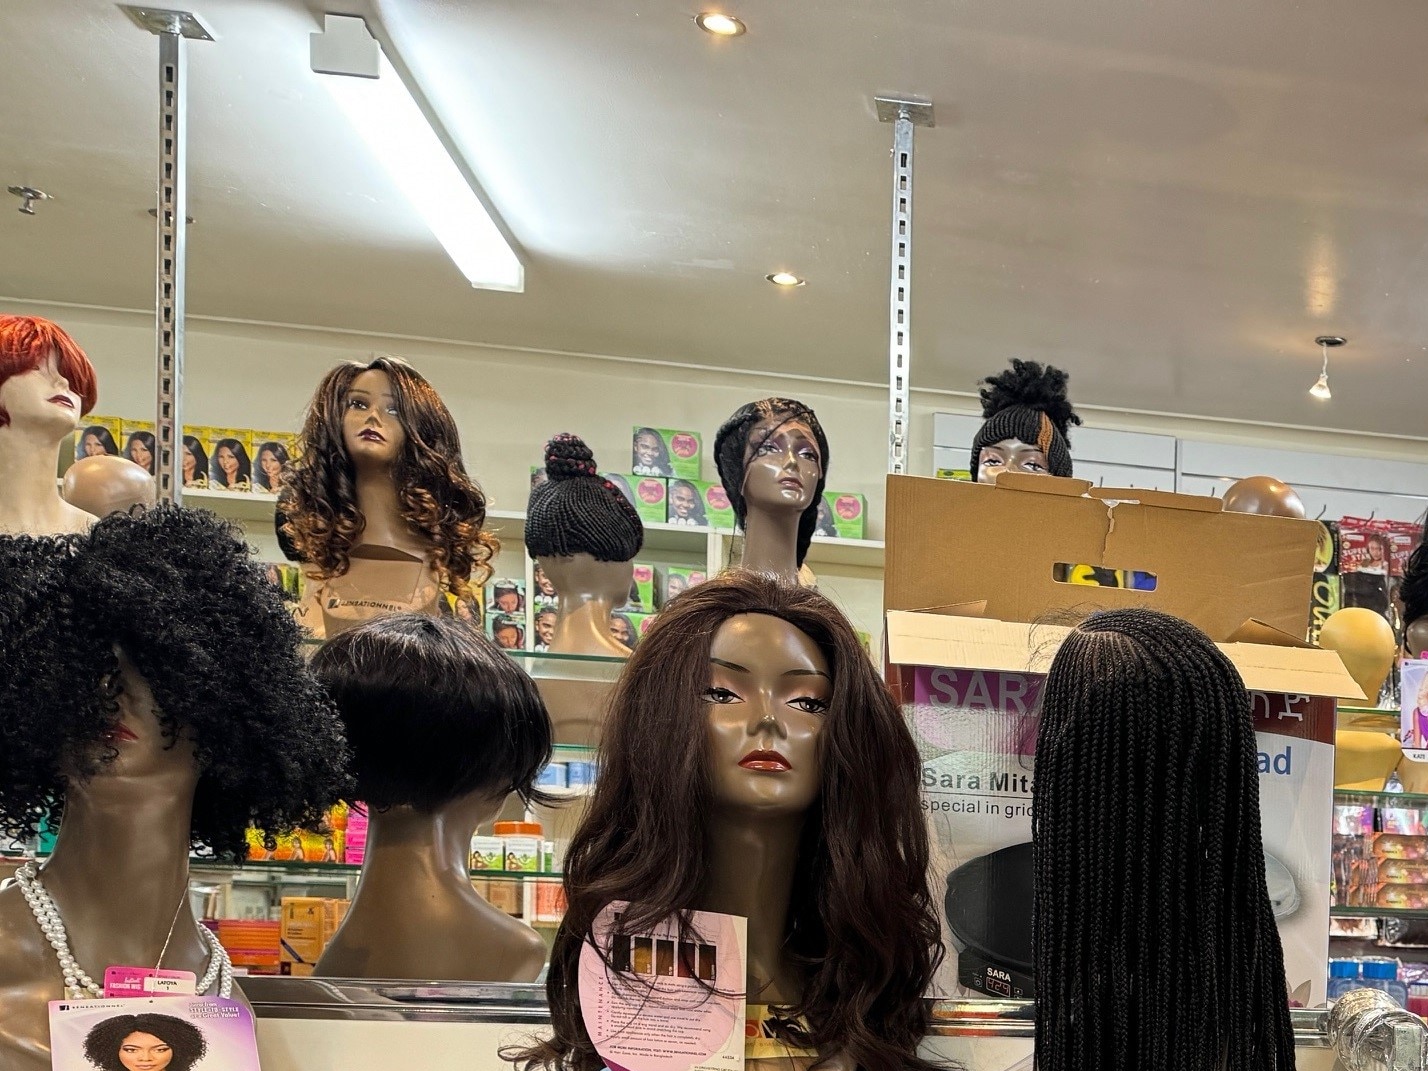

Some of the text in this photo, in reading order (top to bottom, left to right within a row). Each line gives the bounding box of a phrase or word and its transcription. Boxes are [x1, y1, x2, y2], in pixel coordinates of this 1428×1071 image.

[921, 768, 980, 790] Sara
[921, 799, 999, 815] special in
[986, 967, 1011, 981] SARA
